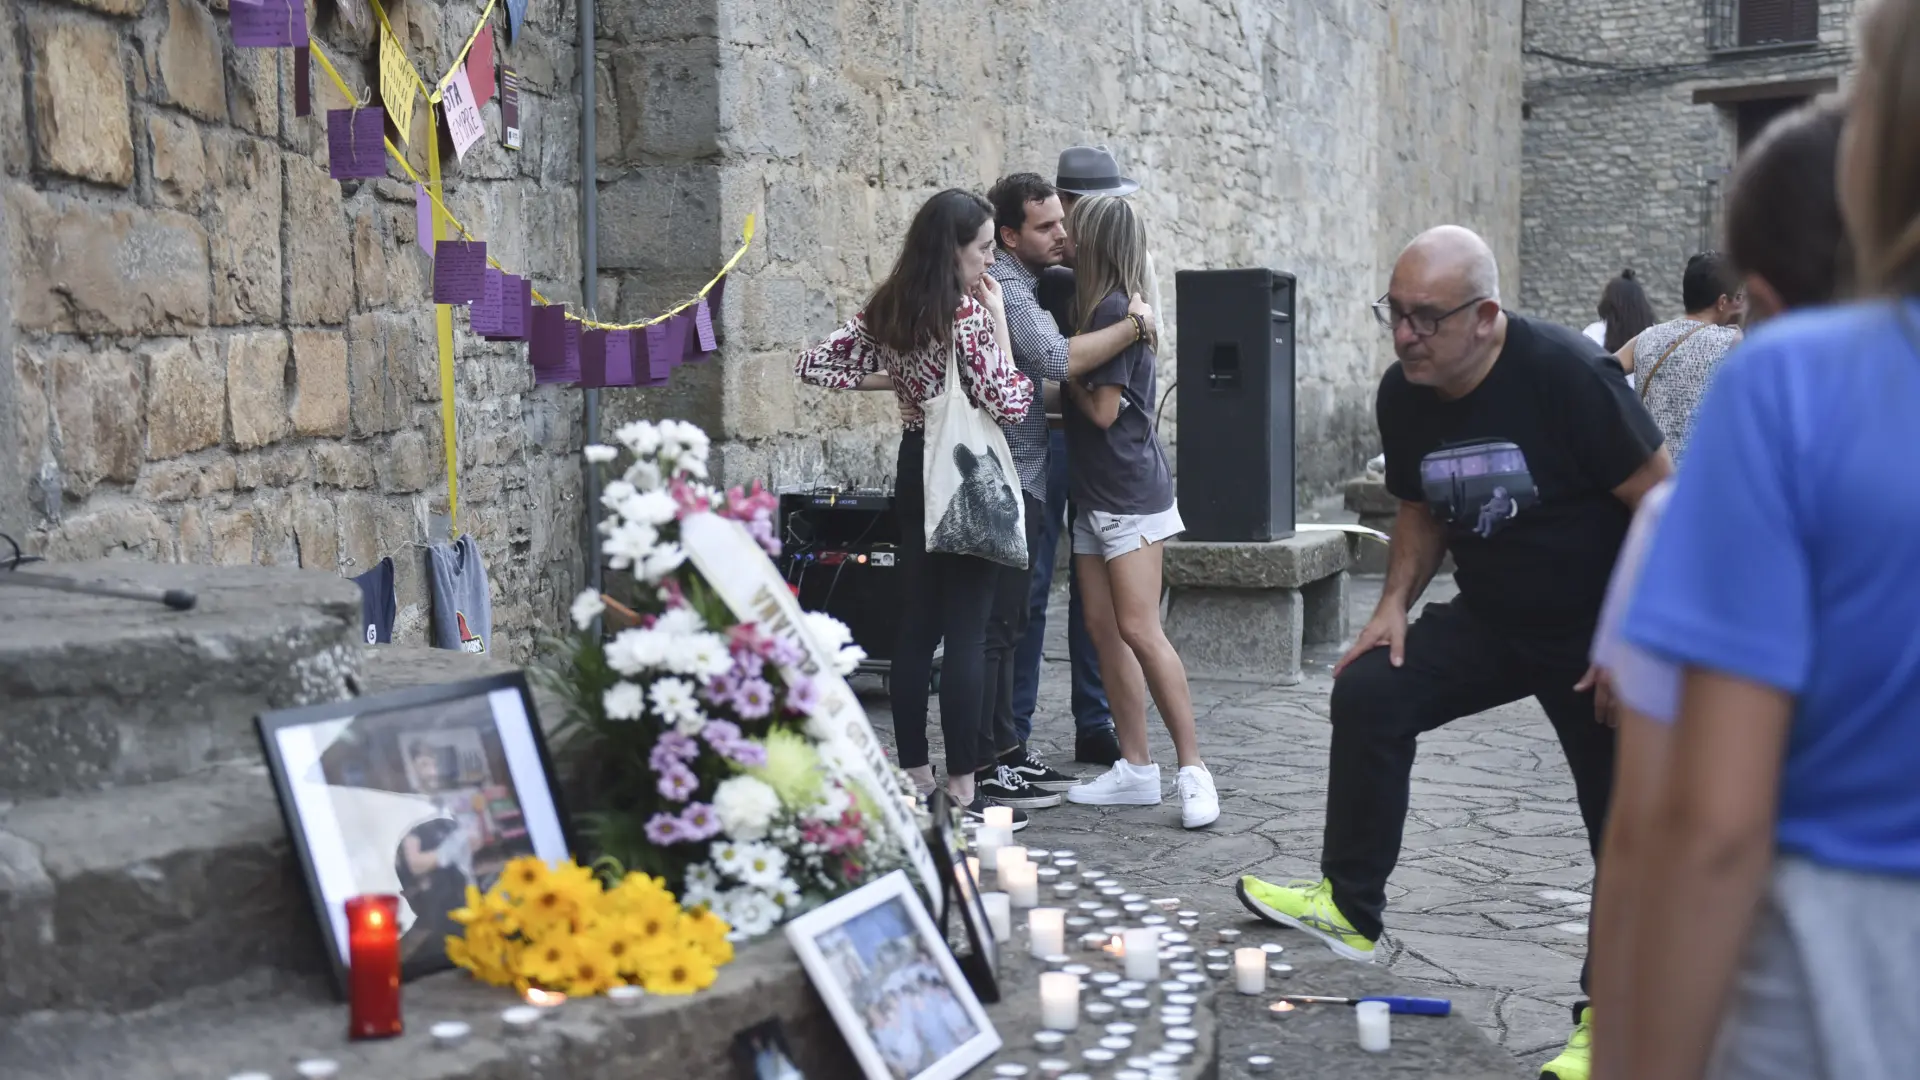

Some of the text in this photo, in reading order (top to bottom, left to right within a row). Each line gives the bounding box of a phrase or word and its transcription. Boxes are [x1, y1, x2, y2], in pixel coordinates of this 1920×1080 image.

[442, 81, 463, 112] STA
[452, 106, 479, 146] EMPRE
[1101, 522, 1120, 532] PUMA
